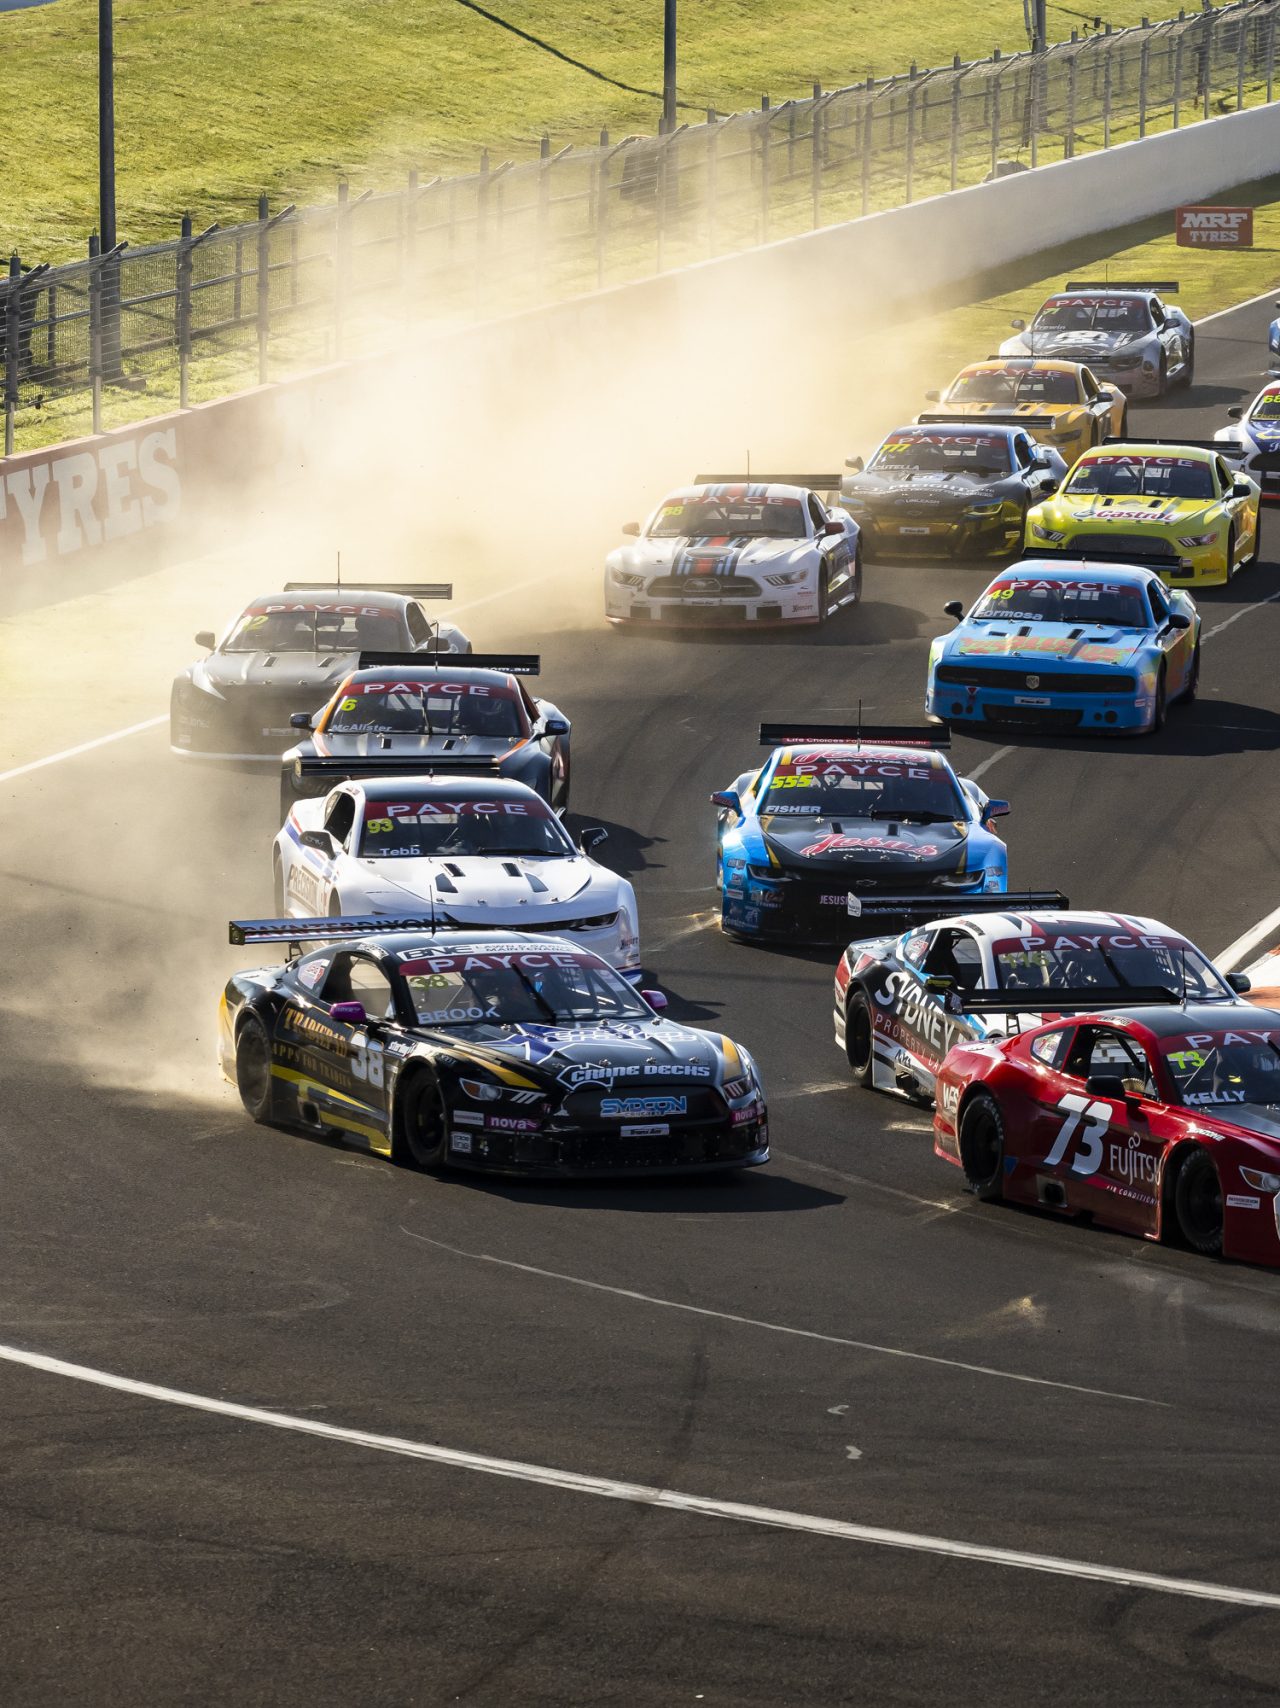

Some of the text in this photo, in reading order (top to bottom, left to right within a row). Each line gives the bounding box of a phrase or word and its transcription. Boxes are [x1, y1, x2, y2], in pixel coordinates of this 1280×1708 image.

[1182, 213, 1247, 229] MRF
[1190, 231, 1238, 242] TYRES
[1056, 299, 1133, 307] PAYCE
[975, 370, 1061, 378] PAYCE
[899, 436, 992, 447] PAYCE
[1097, 456, 1194, 467] PAYCE
[682, 496, 784, 505] PAYCE
[1096, 510, 1175, 521] Castrol
[1010, 581, 1121, 593] PAYCE
[988, 589, 1015, 600] 49
[266, 605, 381, 617] PAYCE
[363, 683, 491, 696] PAYCE
[341, 699, 357, 711] 6
[796, 764, 930, 780] PAYCE
[770, 775, 814, 789] 555
[386, 803, 529, 816] PAYCE
[765, 805, 822, 814] FISHER
[367, 817, 395, 834] 93
[800, 833, 938, 856] Jesus
[380, 847, 421, 857] Tebb
[1021, 936, 1167, 951] PAYCE
[427, 953, 581, 973] PAYCE
[409, 974, 448, 989] 38
[418, 1006, 501, 1025] BROOK
[874, 971, 955, 1057] SYDNEY
[874, 1013, 926, 1059] PROPERTY
[351, 1031, 385, 1089] 38
[1166, 1050, 1206, 1070] 73
[1182, 1090, 1246, 1105] KELLY
[600, 1095, 687, 1115] SYDCON
[490, 1117, 527, 1130] nova
[1043, 1093, 1113, 1175] 73
[1110, 1143, 1161, 1186] FUJITSU
